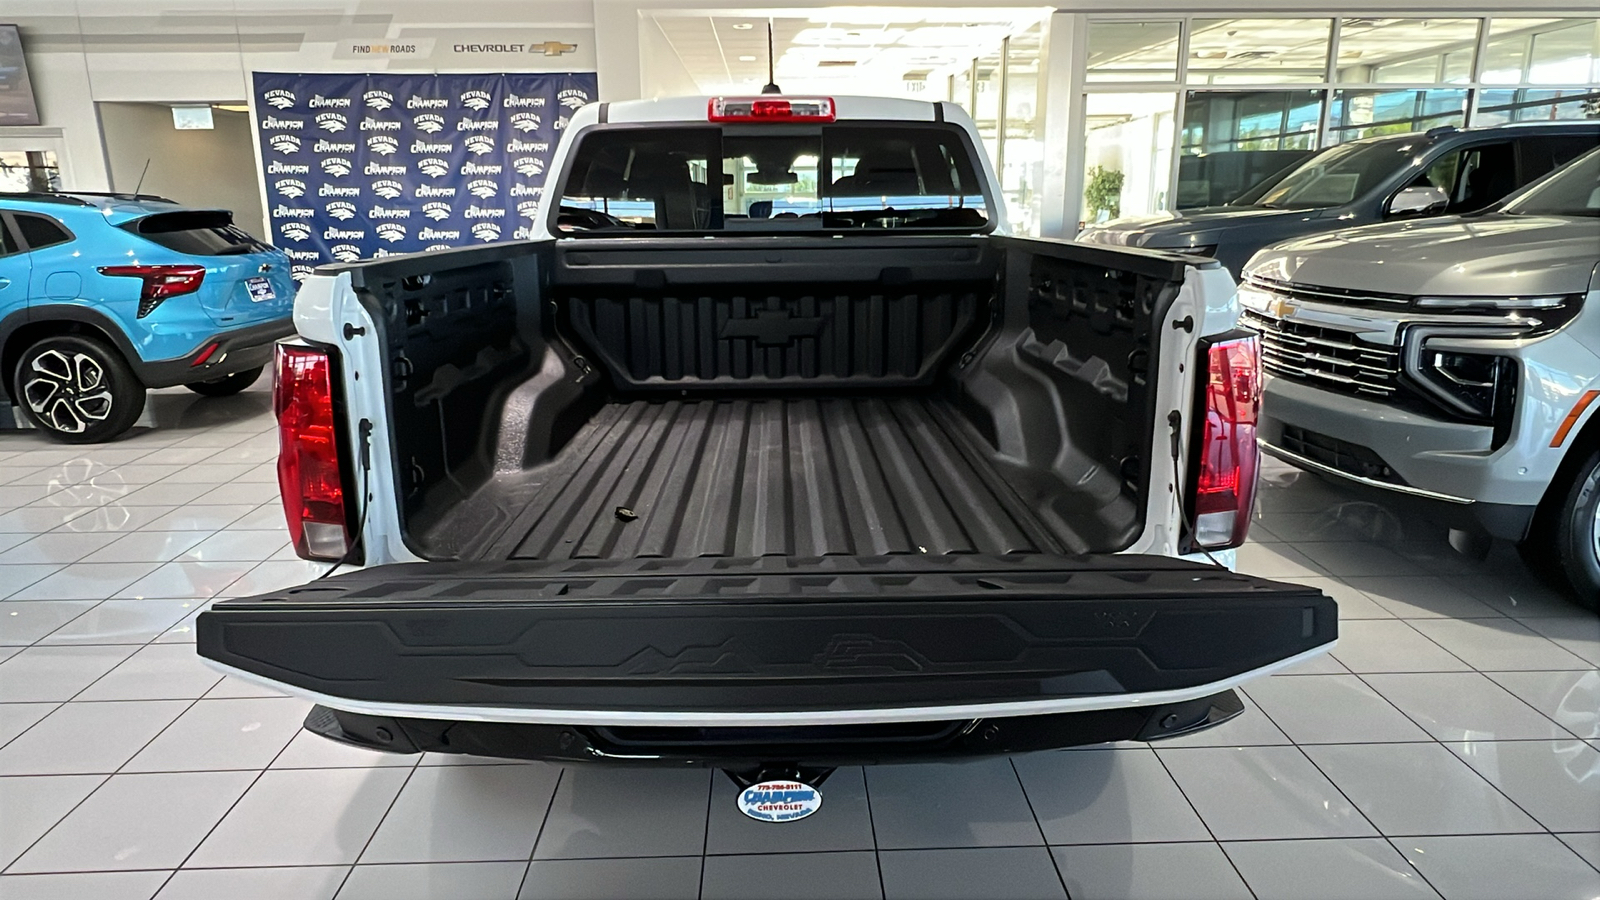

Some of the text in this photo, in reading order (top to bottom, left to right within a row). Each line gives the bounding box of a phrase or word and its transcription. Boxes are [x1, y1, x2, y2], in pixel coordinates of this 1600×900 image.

[352, 45, 416, 53] FIND NEW ROADS
[453, 44, 525, 53] CHEVROLET
[264, 90, 296, 100] NEVADA
[363, 90, 394, 101] NEVADA
[461, 90, 491, 101] NEVADA
[557, 89, 588, 100] NEVADA
[309, 97, 350, 108] CHAMPION
[407, 98, 448, 109] CHAMPION
[504, 97, 545, 108] CHAMPION
[315, 113, 347, 124] NEVADA
[414, 114, 444, 124] NEVADA
[511, 113, 541, 123] NEVADA
[262, 118, 303, 130] CHAMPION
[360, 120, 401, 130] CHAMPION
[457, 119, 498, 131] CHAMPION
[270, 135, 301, 145] NEVADA
[367, 136, 398, 147] NEVADA
[464, 136, 495, 146] NEVADA
[314, 142, 355, 153] CHAMPION
[410, 143, 452, 154] CHAMPION
[507, 142, 548, 153] CHAMPION
[321, 158, 352, 168] NEVADA
[418, 158, 449, 168] NEVADA
[514, 157, 544, 168] NEVADA
[268, 164, 309, 175] CHAMPION
[364, 165, 406, 175] CHAMPION
[461, 164, 502, 175] CHAMPION
[275, 179, 306, 190] NEVADA
[372, 180, 403, 191] NEVADA
[467, 180, 498, 190] NEVADA
[319, 186, 360, 197] CHAMPION
[415, 187, 456, 197] CHAMPION
[326, 202, 356, 212] NEVADA
[422, 202, 451, 212] NEVADA
[517, 201, 540, 211] NEVA
[273, 208, 314, 218] CHAMPION
[369, 208, 410, 219] CHAMPION
[464, 208, 505, 218] CHAMPION
[281, 223, 311, 232] NEVADA
[376, 223, 406, 234] NEVADA
[471, 222, 501, 233] NEVADA
[324, 230, 364, 240] CHAMPION
[419, 230, 460, 240] CHAMPION
[331, 244, 361, 255] NEVADA
